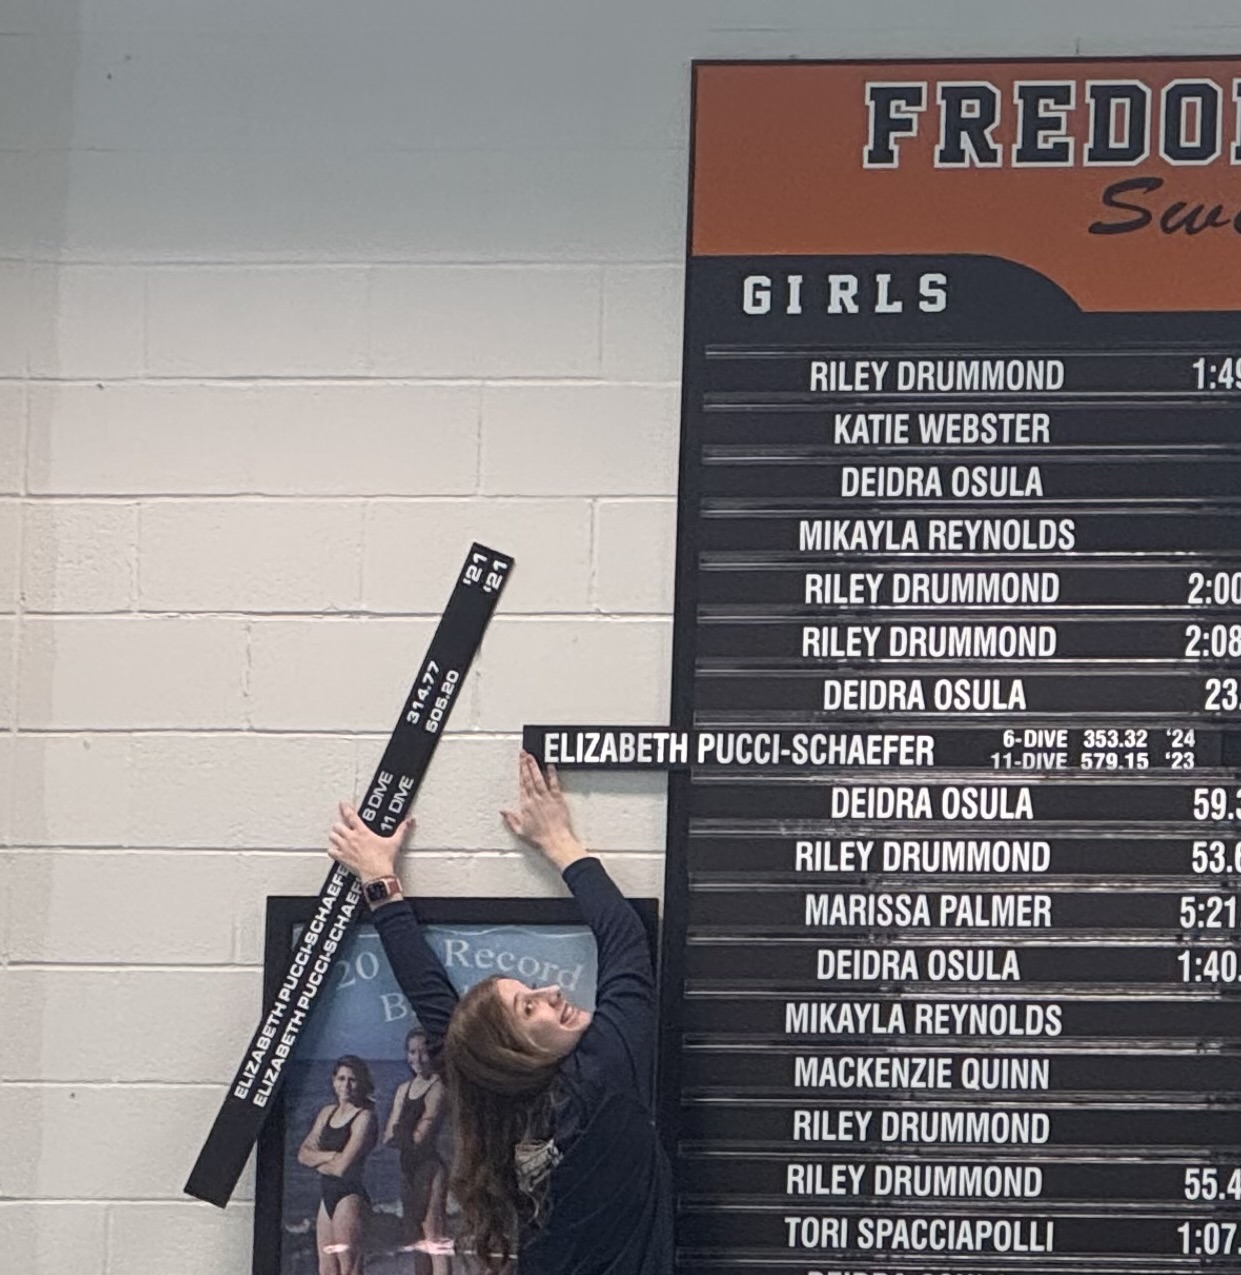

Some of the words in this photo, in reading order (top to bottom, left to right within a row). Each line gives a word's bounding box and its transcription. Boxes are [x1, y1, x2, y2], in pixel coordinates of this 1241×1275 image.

[743, 273, 947, 315] GIRLS
[810, 360, 889, 392] RILEY
[897, 359, 1064, 392] DRUMMOND
[805, 573, 884, 604] RILEY
[892, 572, 1060, 604] DRUMMOND
[823, 679, 926, 711] DEIDRA
[933, 678, 1027, 711] OSULA
[544, 732, 688, 764] ELIZABETH
[697, 732, 935, 766] PUCCI-SCHAEFER
[1003, 729, 1069, 748] 6-DIVE
[1083, 728, 1148, 749] 353.32
[990, 751, 1069, 770] 11-DIVE
[1080, 751, 1149, 770] 579.15
[388, 775, 415, 814] DIVE
[831, 786, 933, 819] DEIDRA
[941, 786, 1034, 820] OSULA
[380, 815, 397, 832] 11
[795, 840, 874, 872] RILEY
[882, 840, 1051, 873] DRUMMOND
[234, 1001, 288, 1100] ELIZABETH
[278, 863, 351, 1003] PUCCI-SCHAEFE
[368, 770, 394, 809] DIVE
[406, 660, 440, 725] 314.77
[805, 893, 931, 927] MARISSA
[939, 894, 1052, 927] PALMER
[297, 878, 363, 1011] PUCCI-SCHAEF
[443, 938, 583, 991] Record
[817, 949, 919, 981] DEIDRA
[927, 949, 1021, 981] OSULA
[253, 1011, 307, 1108] ELIZABETH
[786, 1164, 866, 1195] RILEY
[874, 1165, 1043, 1198] DRUMMOND
[784, 1216, 848, 1249] TORI
[857, 1217, 1054, 1252] SPACCIAPOLLI
